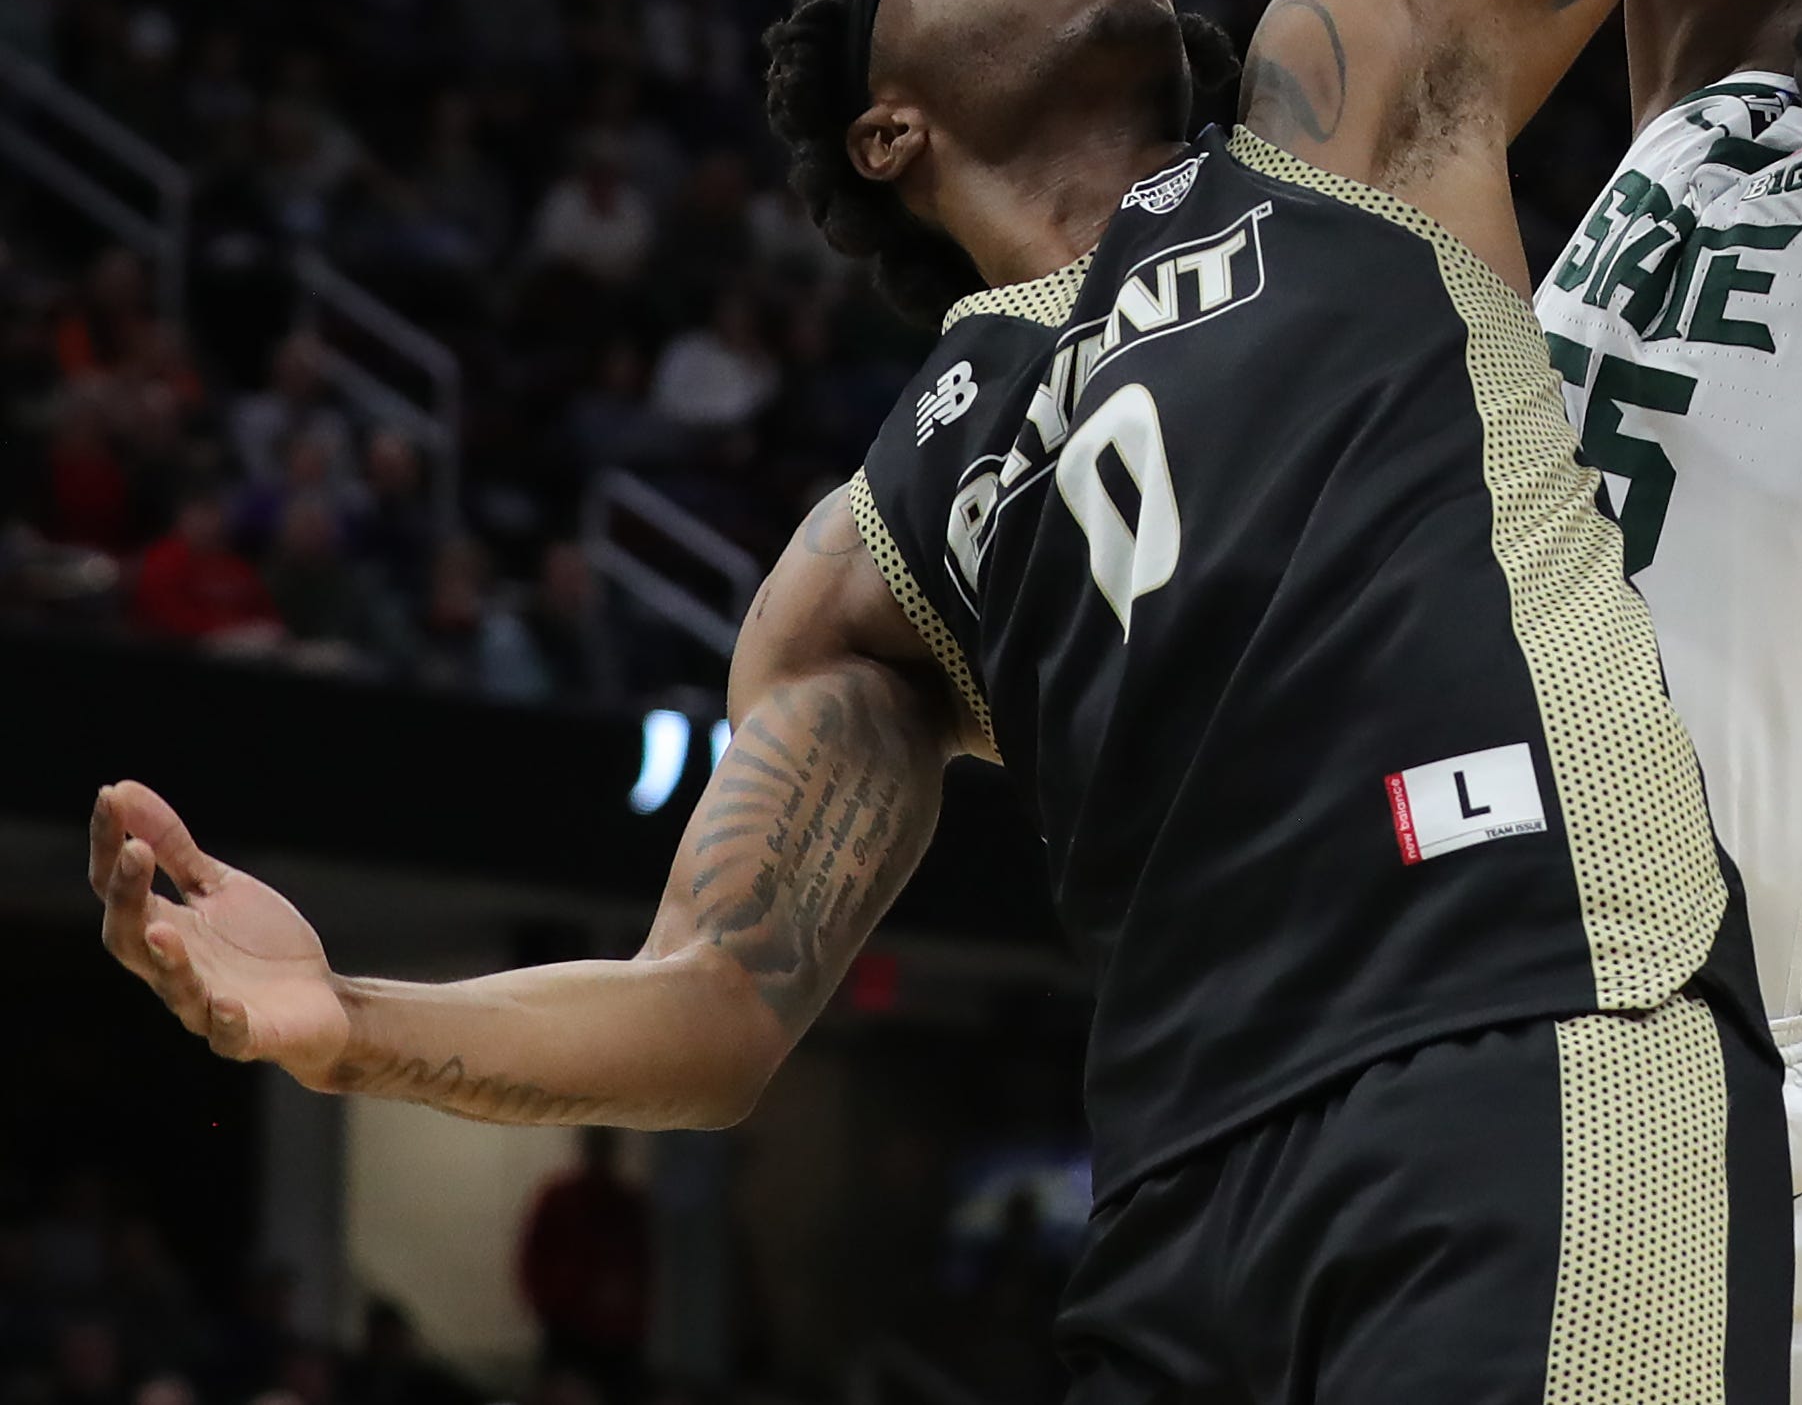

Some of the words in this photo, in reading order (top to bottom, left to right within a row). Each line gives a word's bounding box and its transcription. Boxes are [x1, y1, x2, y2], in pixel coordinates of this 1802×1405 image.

[1056, 383, 1181, 644] 0
[1390, 778, 1409, 832] balance
[1453, 770, 1491, 819] L
[1403, 833, 1417, 860] new
[1484, 825, 1514, 839] TEAM
[1515, 821, 1543, 833] ISSUE
